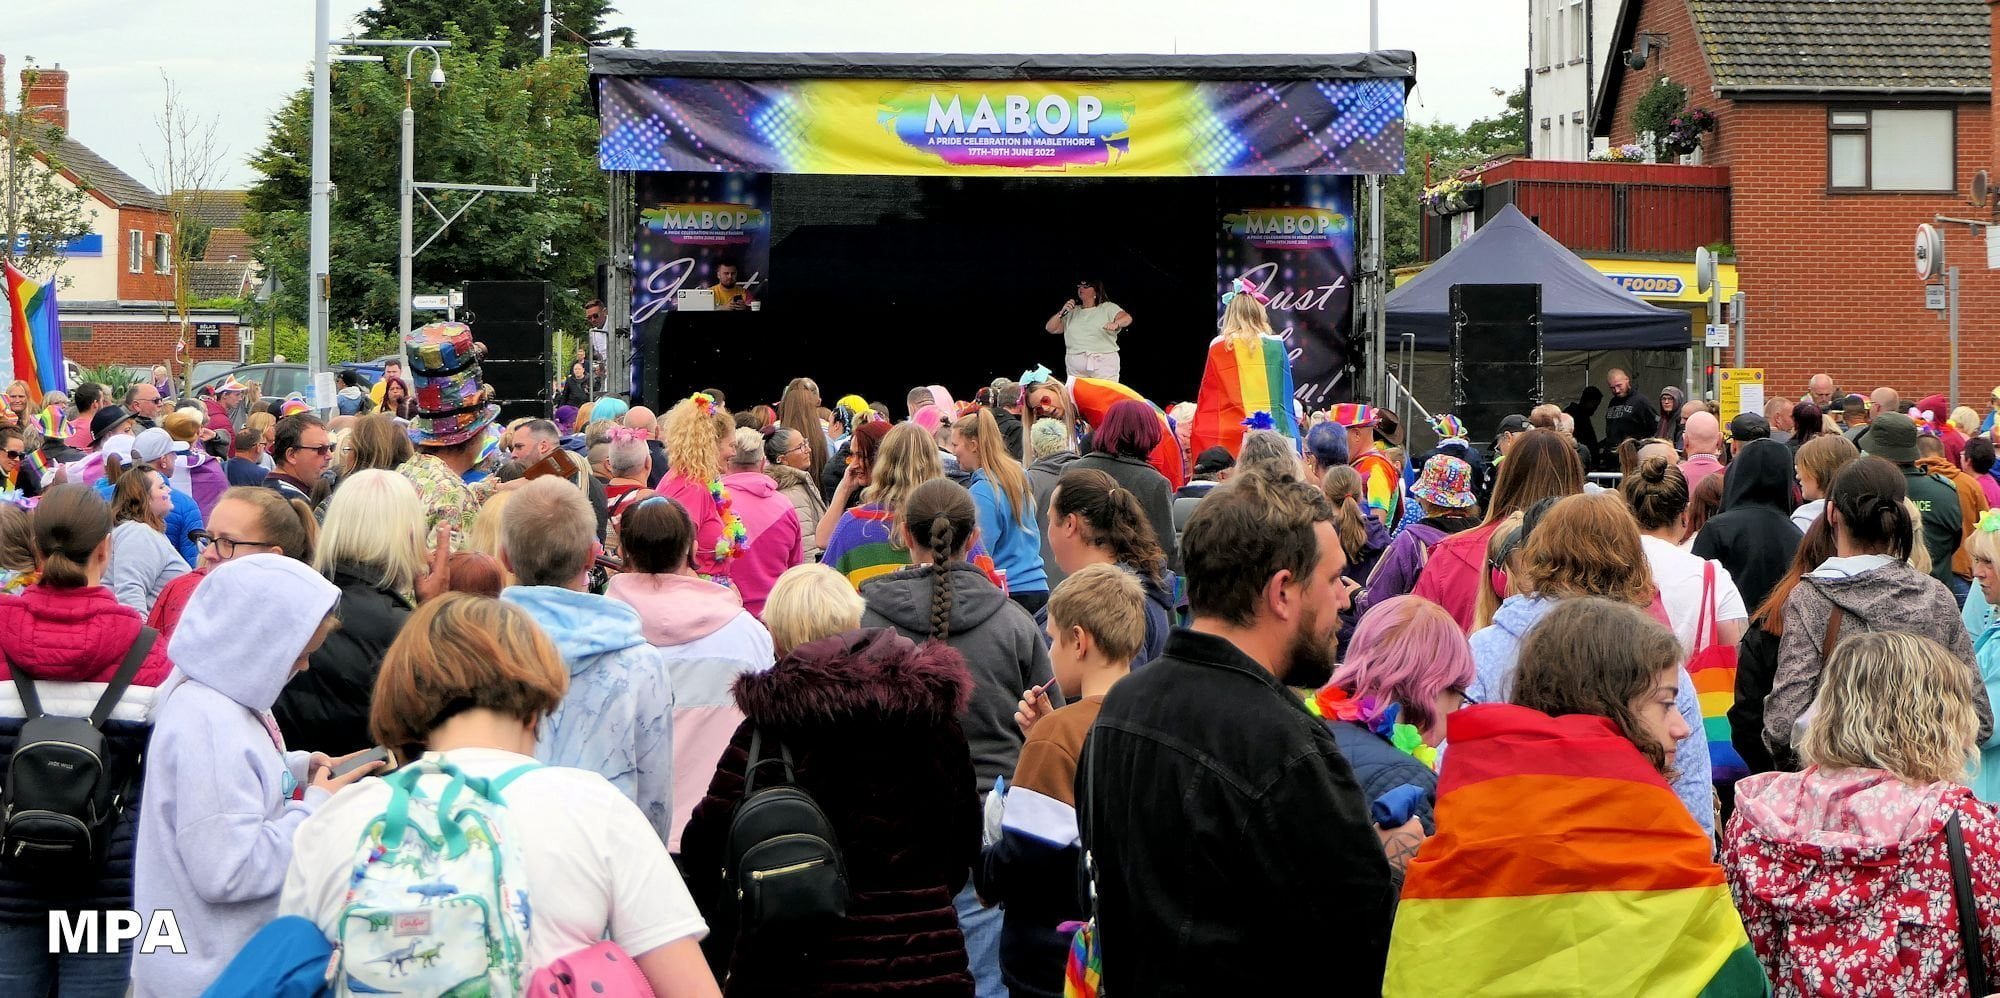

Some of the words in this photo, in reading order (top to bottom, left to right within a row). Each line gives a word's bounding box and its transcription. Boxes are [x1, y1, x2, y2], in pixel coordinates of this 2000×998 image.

[924, 93, 1103, 135] MABOP
[928, 137, 935, 145] A
[936, 138, 962, 146] PRIDE
[963, 138, 1021, 146] CELEBRATION
[1022, 138, 1032, 146] IN
[1033, 138, 1096, 146] MABLETHORPE
[968, 148, 1010, 156] 17TH-19TH
[1011, 148, 1034, 156] JUNE
[1035, 148, 1056, 156] 2022
[663, 211, 748, 231] MABOP
[1245, 215, 1330, 234] MABOP
[1623, 278, 1678, 292] FOODS
